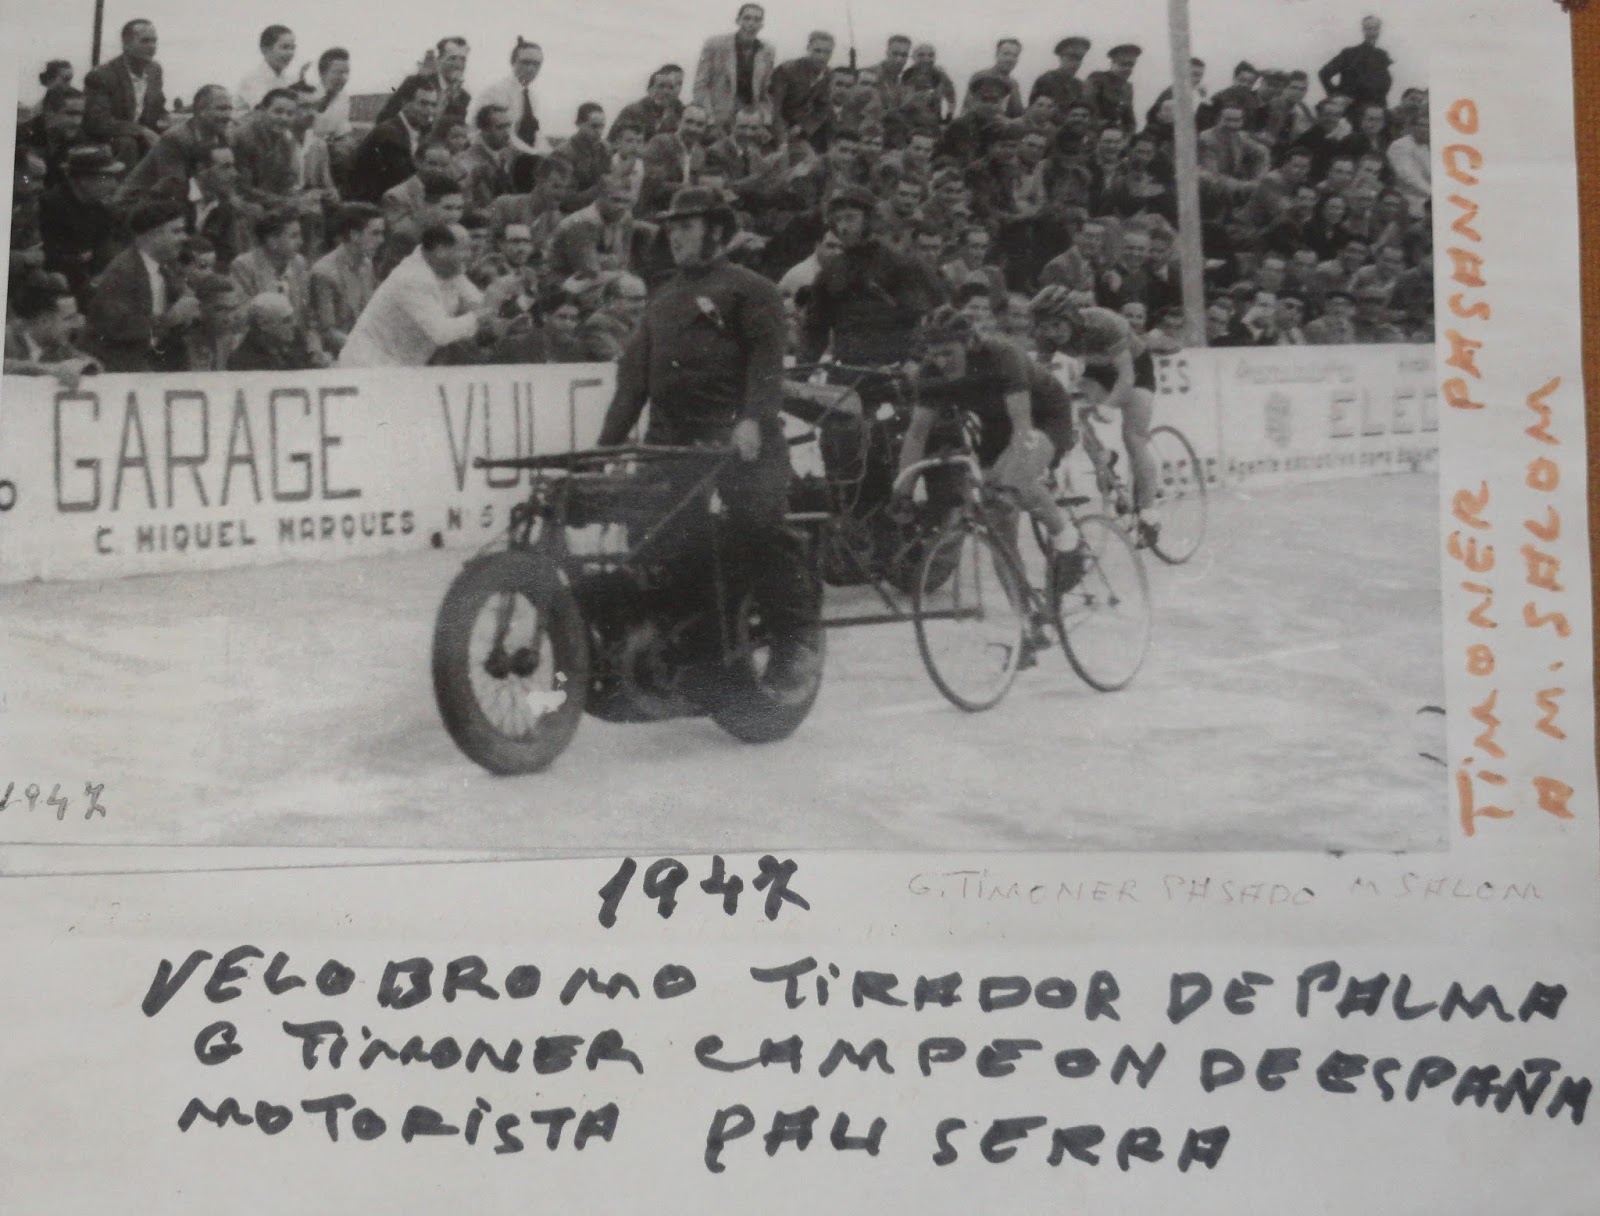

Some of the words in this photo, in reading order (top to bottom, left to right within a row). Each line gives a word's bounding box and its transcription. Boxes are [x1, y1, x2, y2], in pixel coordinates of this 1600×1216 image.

[53, 386, 362, 513] GARAGE
[137, 520, 257, 552] MIQUEL
[279, 509, 416, 543] MARQUES
[1519, 375, 1571, 638] SALOM
[1531, 775, 1576, 820] A
[598, 853, 812, 929] 1947
[1296, 960, 1568, 1023] PALMA
[694, 1034, 1167, 1089] CAMPEON
[932, 1115, 1231, 1173] SERRA
